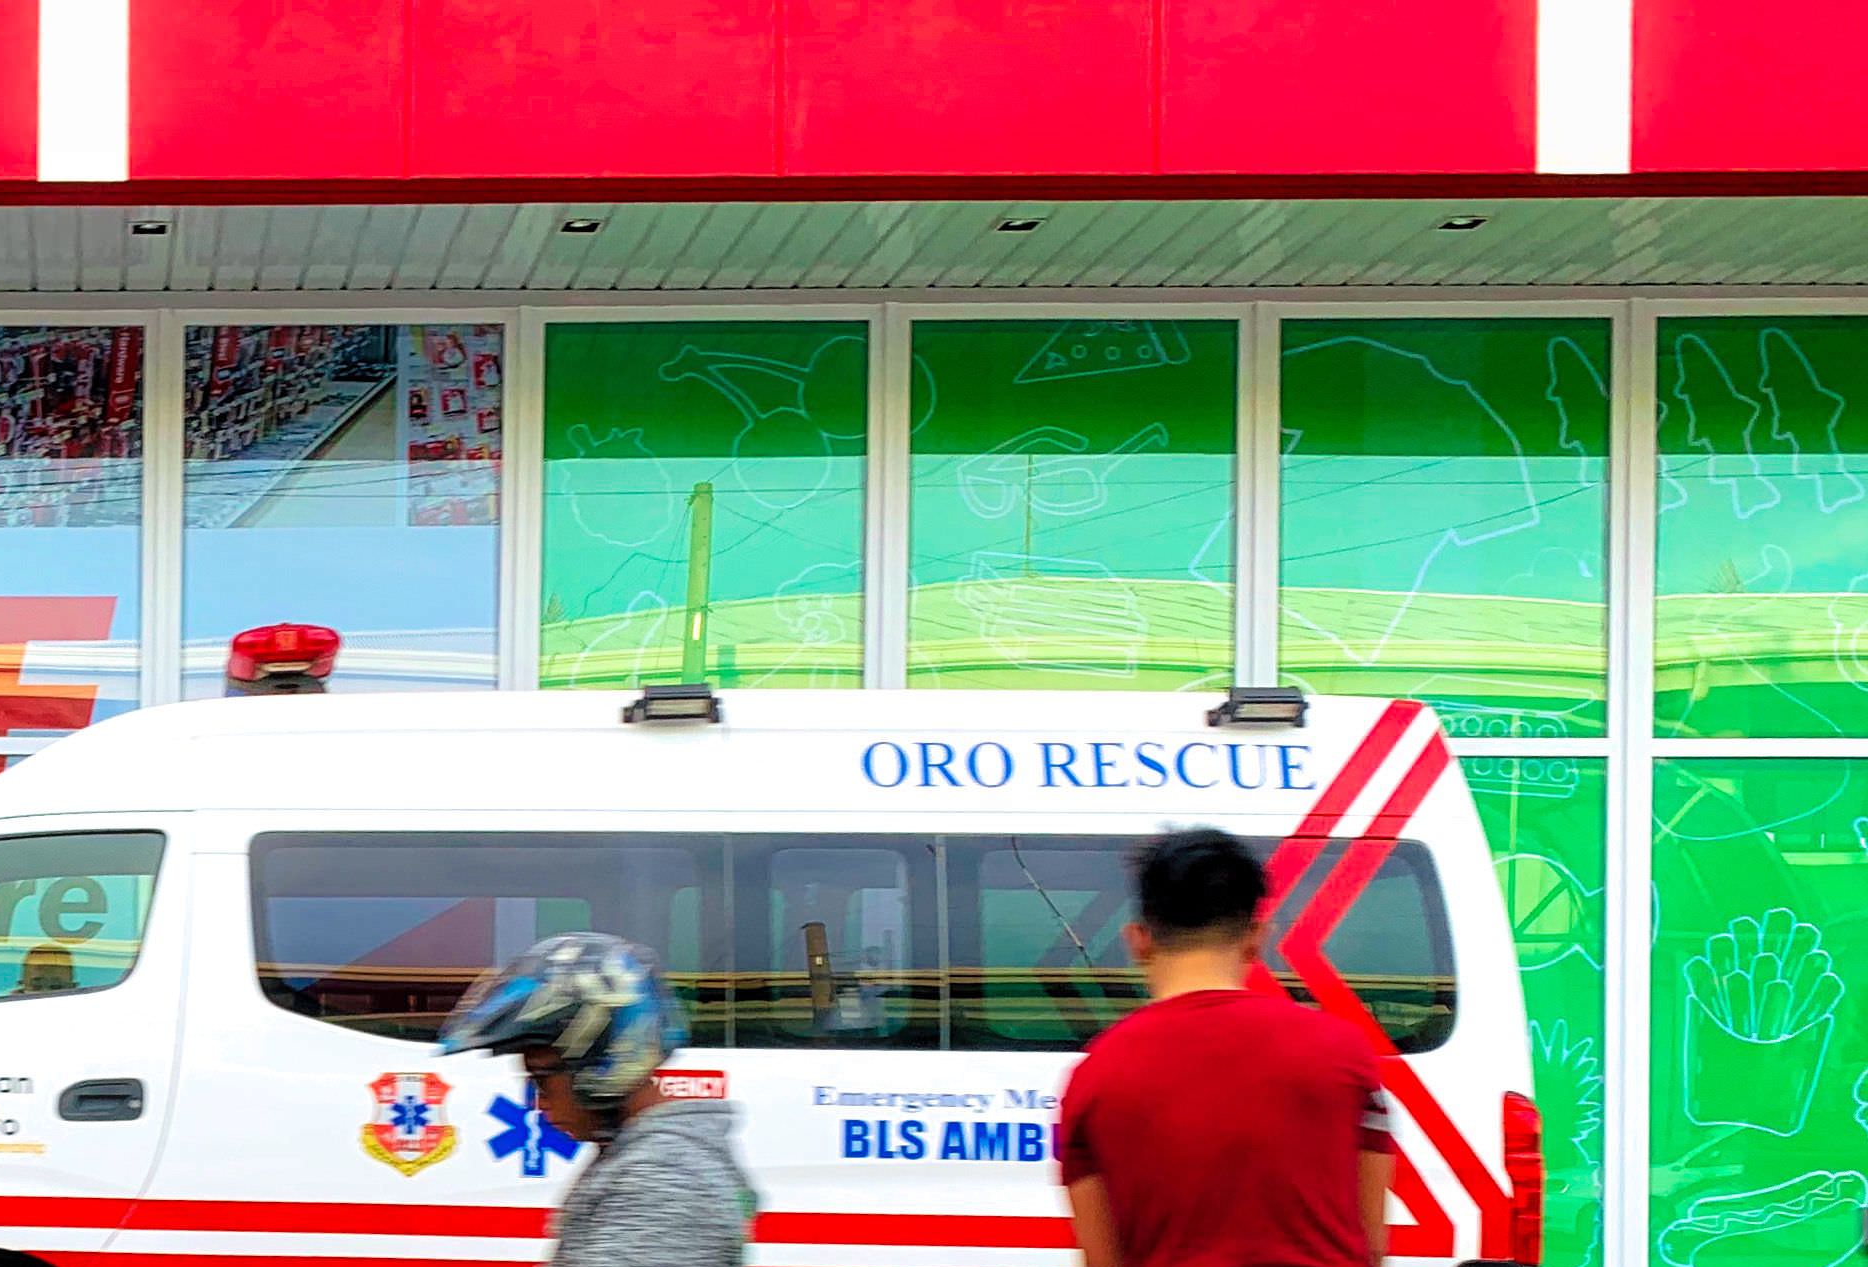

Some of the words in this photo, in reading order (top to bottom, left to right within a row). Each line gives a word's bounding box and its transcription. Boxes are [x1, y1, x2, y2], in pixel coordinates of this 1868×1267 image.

[861, 741, 1015, 789] ORO
[1035, 742, 1318, 791] RESCUE
[812, 1085, 995, 1113] Emergency
[843, 1119, 928, 1160] BLS
